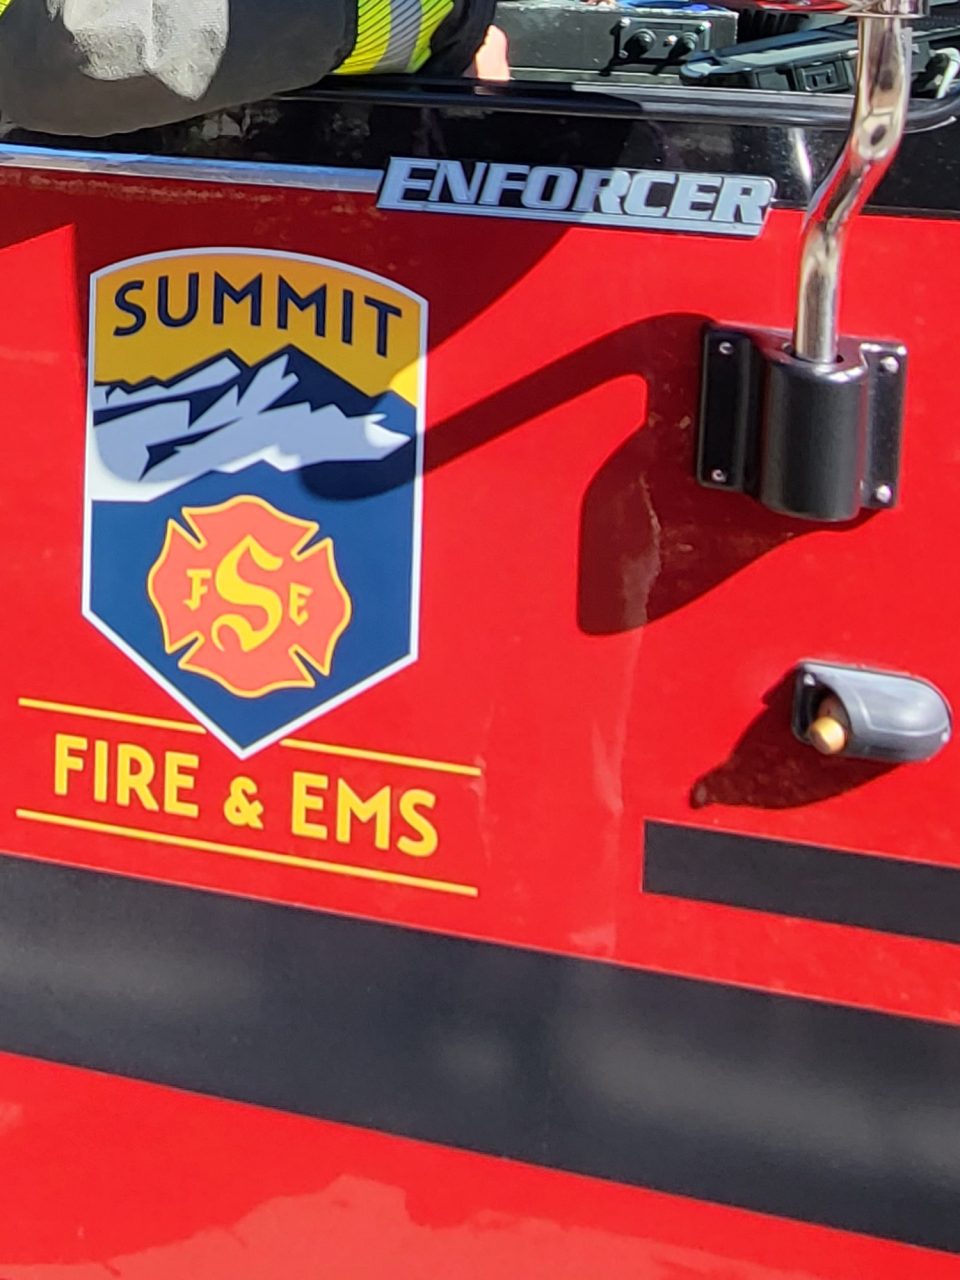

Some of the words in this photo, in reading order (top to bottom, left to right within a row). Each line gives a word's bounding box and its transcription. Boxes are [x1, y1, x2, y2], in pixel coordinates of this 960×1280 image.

[378, 157, 775, 228] ENFORCER
[112, 271, 403, 358] SUMMIT
[54, 733, 200, 818] FIRE
[223, 775, 264, 830] &
[291, 770, 439, 858] EMS
